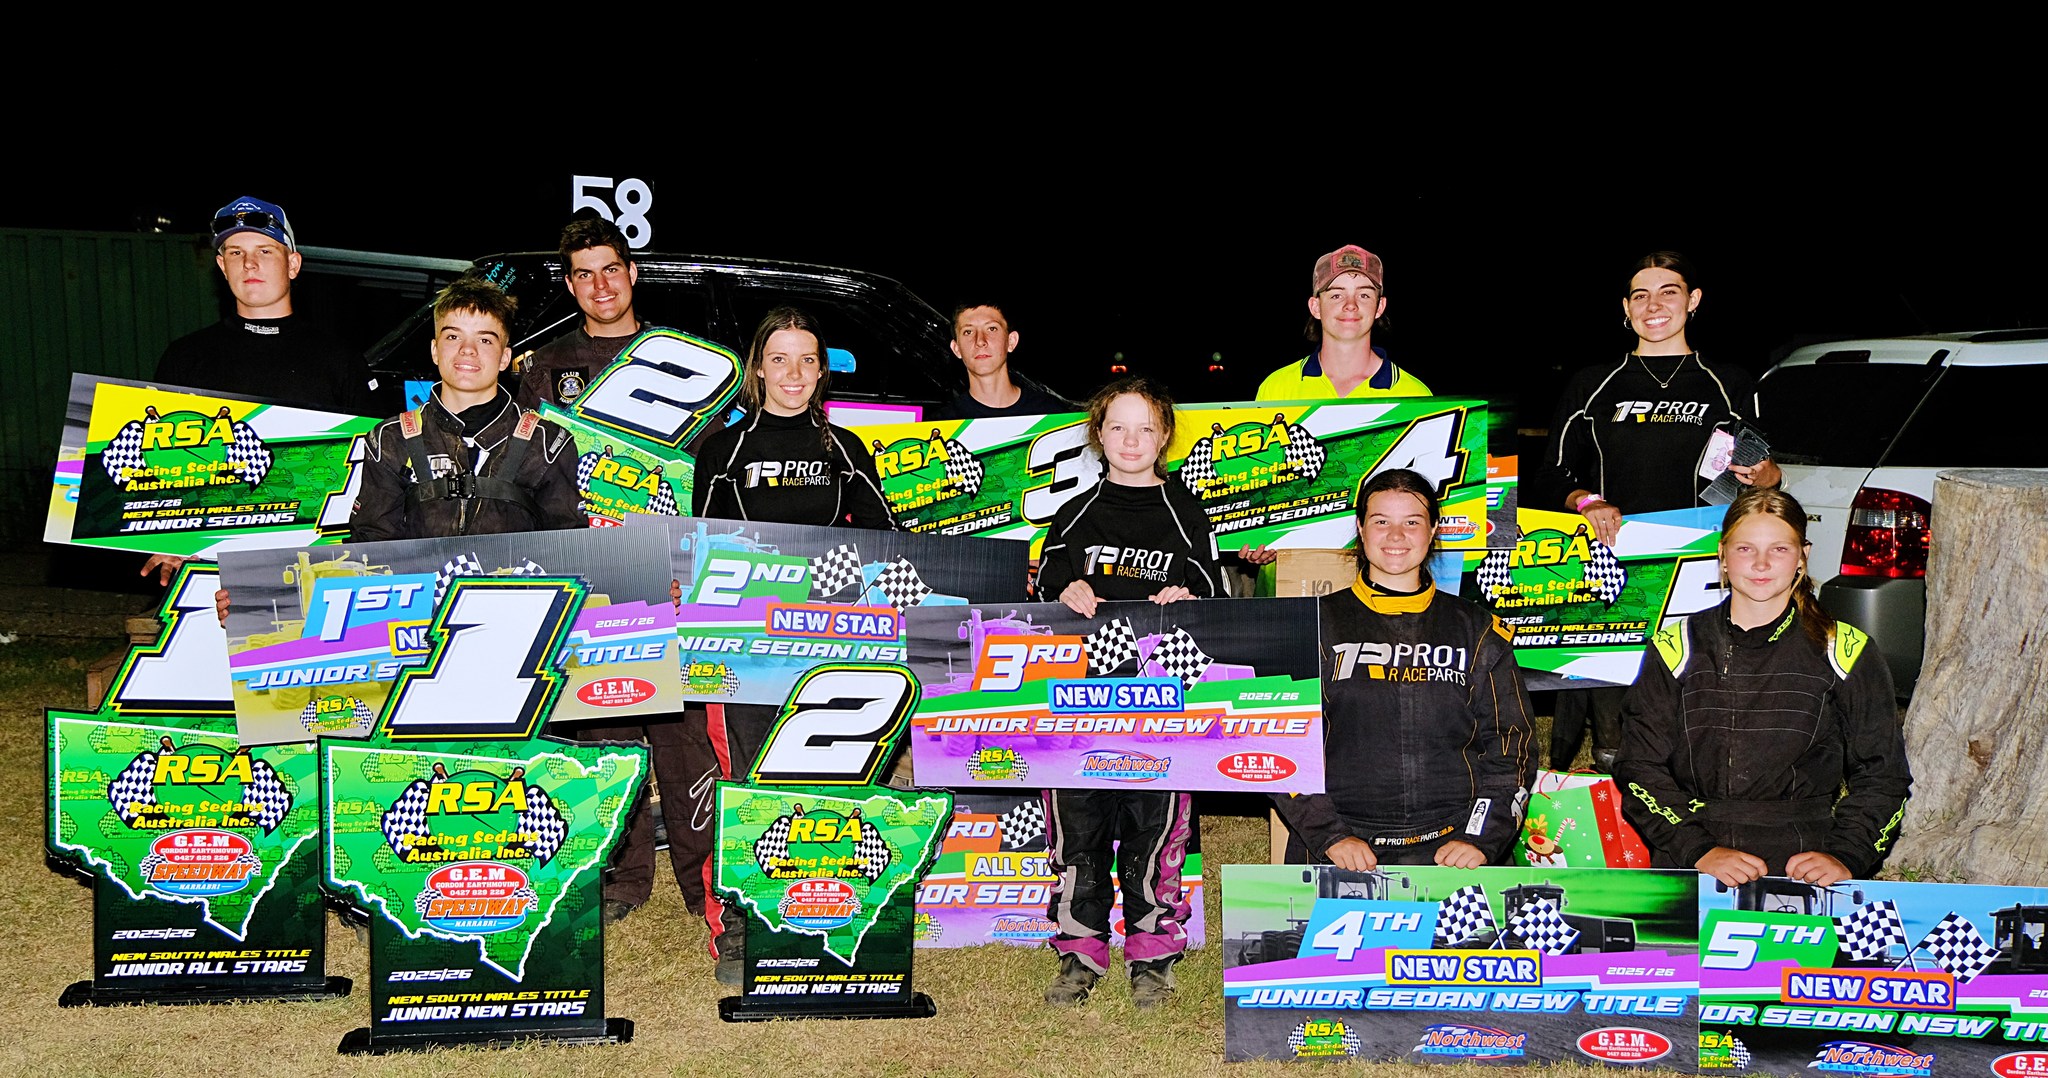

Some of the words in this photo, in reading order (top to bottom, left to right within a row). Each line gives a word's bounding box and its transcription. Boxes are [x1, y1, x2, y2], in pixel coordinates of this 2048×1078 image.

[573, 175, 652, 249] 58
[582, 336, 734, 436] 2
[1654, 401, 1710, 416] PRO1
[1651, 414, 1702, 425] RACEPARTS
[142, 418, 236, 449] RSA
[1212, 423, 1291, 461] RSA
[875, 439, 950, 479] RSA
[1364, 411, 1462, 492] 4
[122, 466, 180, 479] Racing
[186, 459, 247, 473] Sedans
[591, 457, 659, 496] RSA
[1196, 472, 1247, 489] Racing
[1252, 459, 1304, 477] Sedans
[126, 475, 204, 492] Australia
[210, 474, 240, 486] Inc.
[782, 475, 831, 486] RACEPARTS
[916, 474, 964, 492] Sedans
[1202, 479, 1268, 500] Australia
[1272, 473, 1299, 484] Inc.
[937, 489, 961, 501] Inc.
[123, 511, 153, 519] NEW
[155, 508, 204, 517] SOUTH
[209, 504, 255, 514] WALES
[258, 501, 299, 511] TITLE
[124, 499, 182, 510] 2025/26
[1225, 506, 1266, 520] SOUTH
[1268, 497, 1309, 511] WALES
[1312, 490, 1349, 502] TITLE
[1269, 500, 1347, 524] SEDANS
[121, 517, 202, 532] JUNIOR
[207, 513, 296, 527] SEDANS
[939, 512, 976, 527] WALES
[979, 503, 1012, 516] TITLE
[1120, 547, 1174, 571] PRO1
[1509, 535, 1592, 566] RSA
[699, 558, 805, 606] 2ND
[1117, 566, 1168, 582] RACEPARTS
[1492, 584, 1543, 595] Racing
[1547, 578, 1602, 591] Sedans
[1495, 595, 1563, 608] Australia
[1567, 593, 1596, 603] Inc.
[320, 583, 423, 641] 1ST
[595, 617, 655, 628] 2025/26
[773, 610, 833, 631] NEW
[836, 615, 892, 634] STAR
[1518, 625, 1560, 634] SOUTH
[1562, 623, 1604, 631] WALES
[1608, 621, 1648, 630] TITLE
[1561, 632, 1644, 644] SEDANS
[393, 589, 558, 726] 1
[578, 643, 663, 662] TITLE
[751, 641, 851, 659] SEDAN
[1392, 643, 1468, 670] PRO1
[689, 665, 726, 676] RSA
[980, 644, 1080, 690] 3RD
[249, 666, 366, 688] JUNIOR
[593, 681, 639, 695] G.E.M.
[1055, 686, 1113, 706] NEW
[1119, 687, 1177, 706] STAR
[1239, 692, 1299, 700] 2025/26
[317, 698, 356, 713] RSA
[758, 672, 906, 773] 2
[927, 719, 1029, 732] JUNIOR
[1035, 719, 1137, 732] SEDAN
[1143, 719, 1215, 732] NSW
[1222, 719, 1309, 734] TITLE
[980, 750, 1014, 762] RSA
[1085, 756, 1171, 771] Northwest
[1234, 756, 1279, 769] G.E.M.
[154, 755, 254, 783] RSA
[427, 781, 528, 813] RSA
[130, 802, 193, 815] Racing
[199, 800, 264, 813] Sedans
[133, 816, 215, 829] Australia
[222, 815, 255, 827] Inc.
[788, 819, 862, 842] RSA
[175, 836, 229, 847] G.E.M
[404, 833, 467, 846] Racing
[472, 831, 539, 843] Sedans
[407, 849, 489, 862] Australia
[494, 846, 530, 859] Inc.
[769, 857, 817, 867] Racing
[821, 855, 870, 866] Sedans
[153, 864, 253, 879] SPEEDWAY
[450, 868, 505, 880] G.E.M
[771, 868, 834, 878] Australia
[837, 868, 862, 877] Inc.
[974, 858, 1016, 876] ALL
[802, 883, 840, 891] G.E.M
[428, 899, 529, 916] SPEEDWAY
[787, 905, 855, 916] SPEEDWAY
[112, 928, 197, 939] 2025/26
[1312, 911, 1423, 959] 4TH
[200, 950, 262, 958] WALES
[265, 949, 311, 957] TITLE
[1702, 921, 1827, 970] 5TH
[105, 963, 184, 977] JUNIOR
[191, 962, 228, 974] ALL
[234, 960, 307, 973] STARS
[756, 959, 819, 967] 2025/26
[1394, 956, 1460, 979] NEW
[1465, 958, 1535, 981] STAR
[1606, 967, 1675, 976] 2025/26
[388, 970, 473, 981] 2025/26
[388, 995, 423, 1005] NEW
[426, 993, 481, 1003] SOUTH
[485, 991, 538, 1001] WALES
[544, 990, 591, 999] TITLE
[749, 984, 808, 995] JUNIOR
[812, 983, 842, 993] NEW
[845, 983, 901, 993] STARS
[1791, 976, 1863, 1000] NEW
[1870, 982, 1947, 1004] STAR
[1241, 989, 1362, 1005] JUNIOR
[1368, 991, 1487, 1008] SEDAN
[1491, 992, 1575, 1010] NSW
[1583, 995, 1682, 1012] TITLE
[382, 1007, 461, 1021] JUNIOR
[465, 1005, 508, 1018] NEW
[513, 1002, 586, 1016] STARS
[1304, 1023, 1345, 1036] RSA
[1763, 1009, 1893, 1031] SEDAN
[1900, 1017, 1994, 1035] NSW
[1428, 1032, 1525, 1047] Northwest
[1599, 1032, 1650, 1047] G.E.M.
[1824, 1047, 1933, 1069] Northwest
